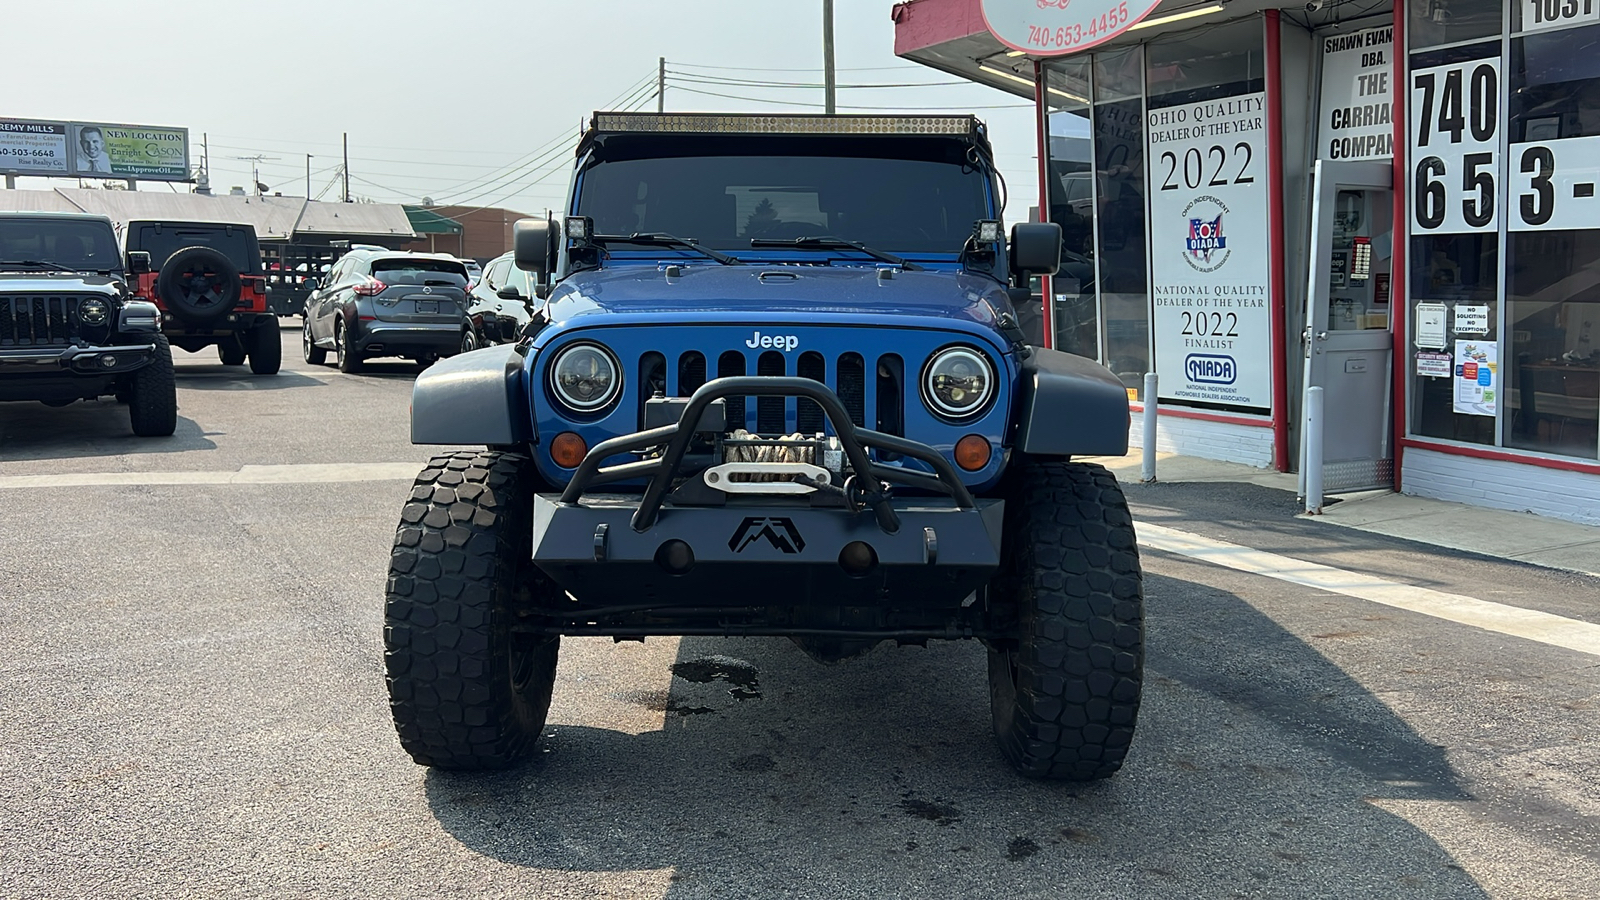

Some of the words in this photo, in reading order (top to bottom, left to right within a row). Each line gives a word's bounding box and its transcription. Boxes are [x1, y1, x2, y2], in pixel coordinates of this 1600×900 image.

[1027, 1, 1129, 47] 740-653-4455
[1325, 34, 1363, 54] SHAWN
[1366, 28, 1394, 47] EVAN
[1361, 51, 1386, 68] DBA.
[1358, 72, 1388, 97] THE
[1150, 109, 1187, 127] OHIO
[1193, 97, 1264, 122] QUALITY
[1414, 64, 1497, 147] 740
[1331, 103, 1394, 130] CARRIA
[27, 125, 54, 133] MILLS
[107, 130, 128, 138] NEW
[132, 132, 182, 141] LOCATION
[1151, 122, 1190, 143] DEALER
[1192, 125, 1206, 138] OF
[1208, 122, 1230, 135] THE
[1232, 117, 1262, 132] YEAR
[33, 159, 52, 167] Realty
[111, 149, 141, 158] Enright
[1161, 142, 1254, 191] 2022
[1181, 201, 1193, 217] OHIO
[1194, 195, 1230, 214] INDEPENDENT
[1190, 238, 1219, 249] OIADA
[1155, 285, 1210, 295] NATIONAL
[1214, 285, 1265, 297] QUALITY
[1156, 298, 1193, 307] DEALER
[1196, 298, 1209, 307] OF
[1213, 299, 1233, 307] THE
[1236, 299, 1265, 308] YEAR
[1181, 311, 1239, 337] 2022
[745, 331, 799, 352] Jeep
[1185, 339, 1233, 349] FINALIST
[1189, 359, 1232, 379] NIADA
[1174, 390, 1201, 398] AUTOMOBILE
[1201, 392, 1220, 400] DEALERS
[1220, 393, 1251, 403] ASSOCIATION
[1208, 385, 1237, 394] INDEPENDENT
